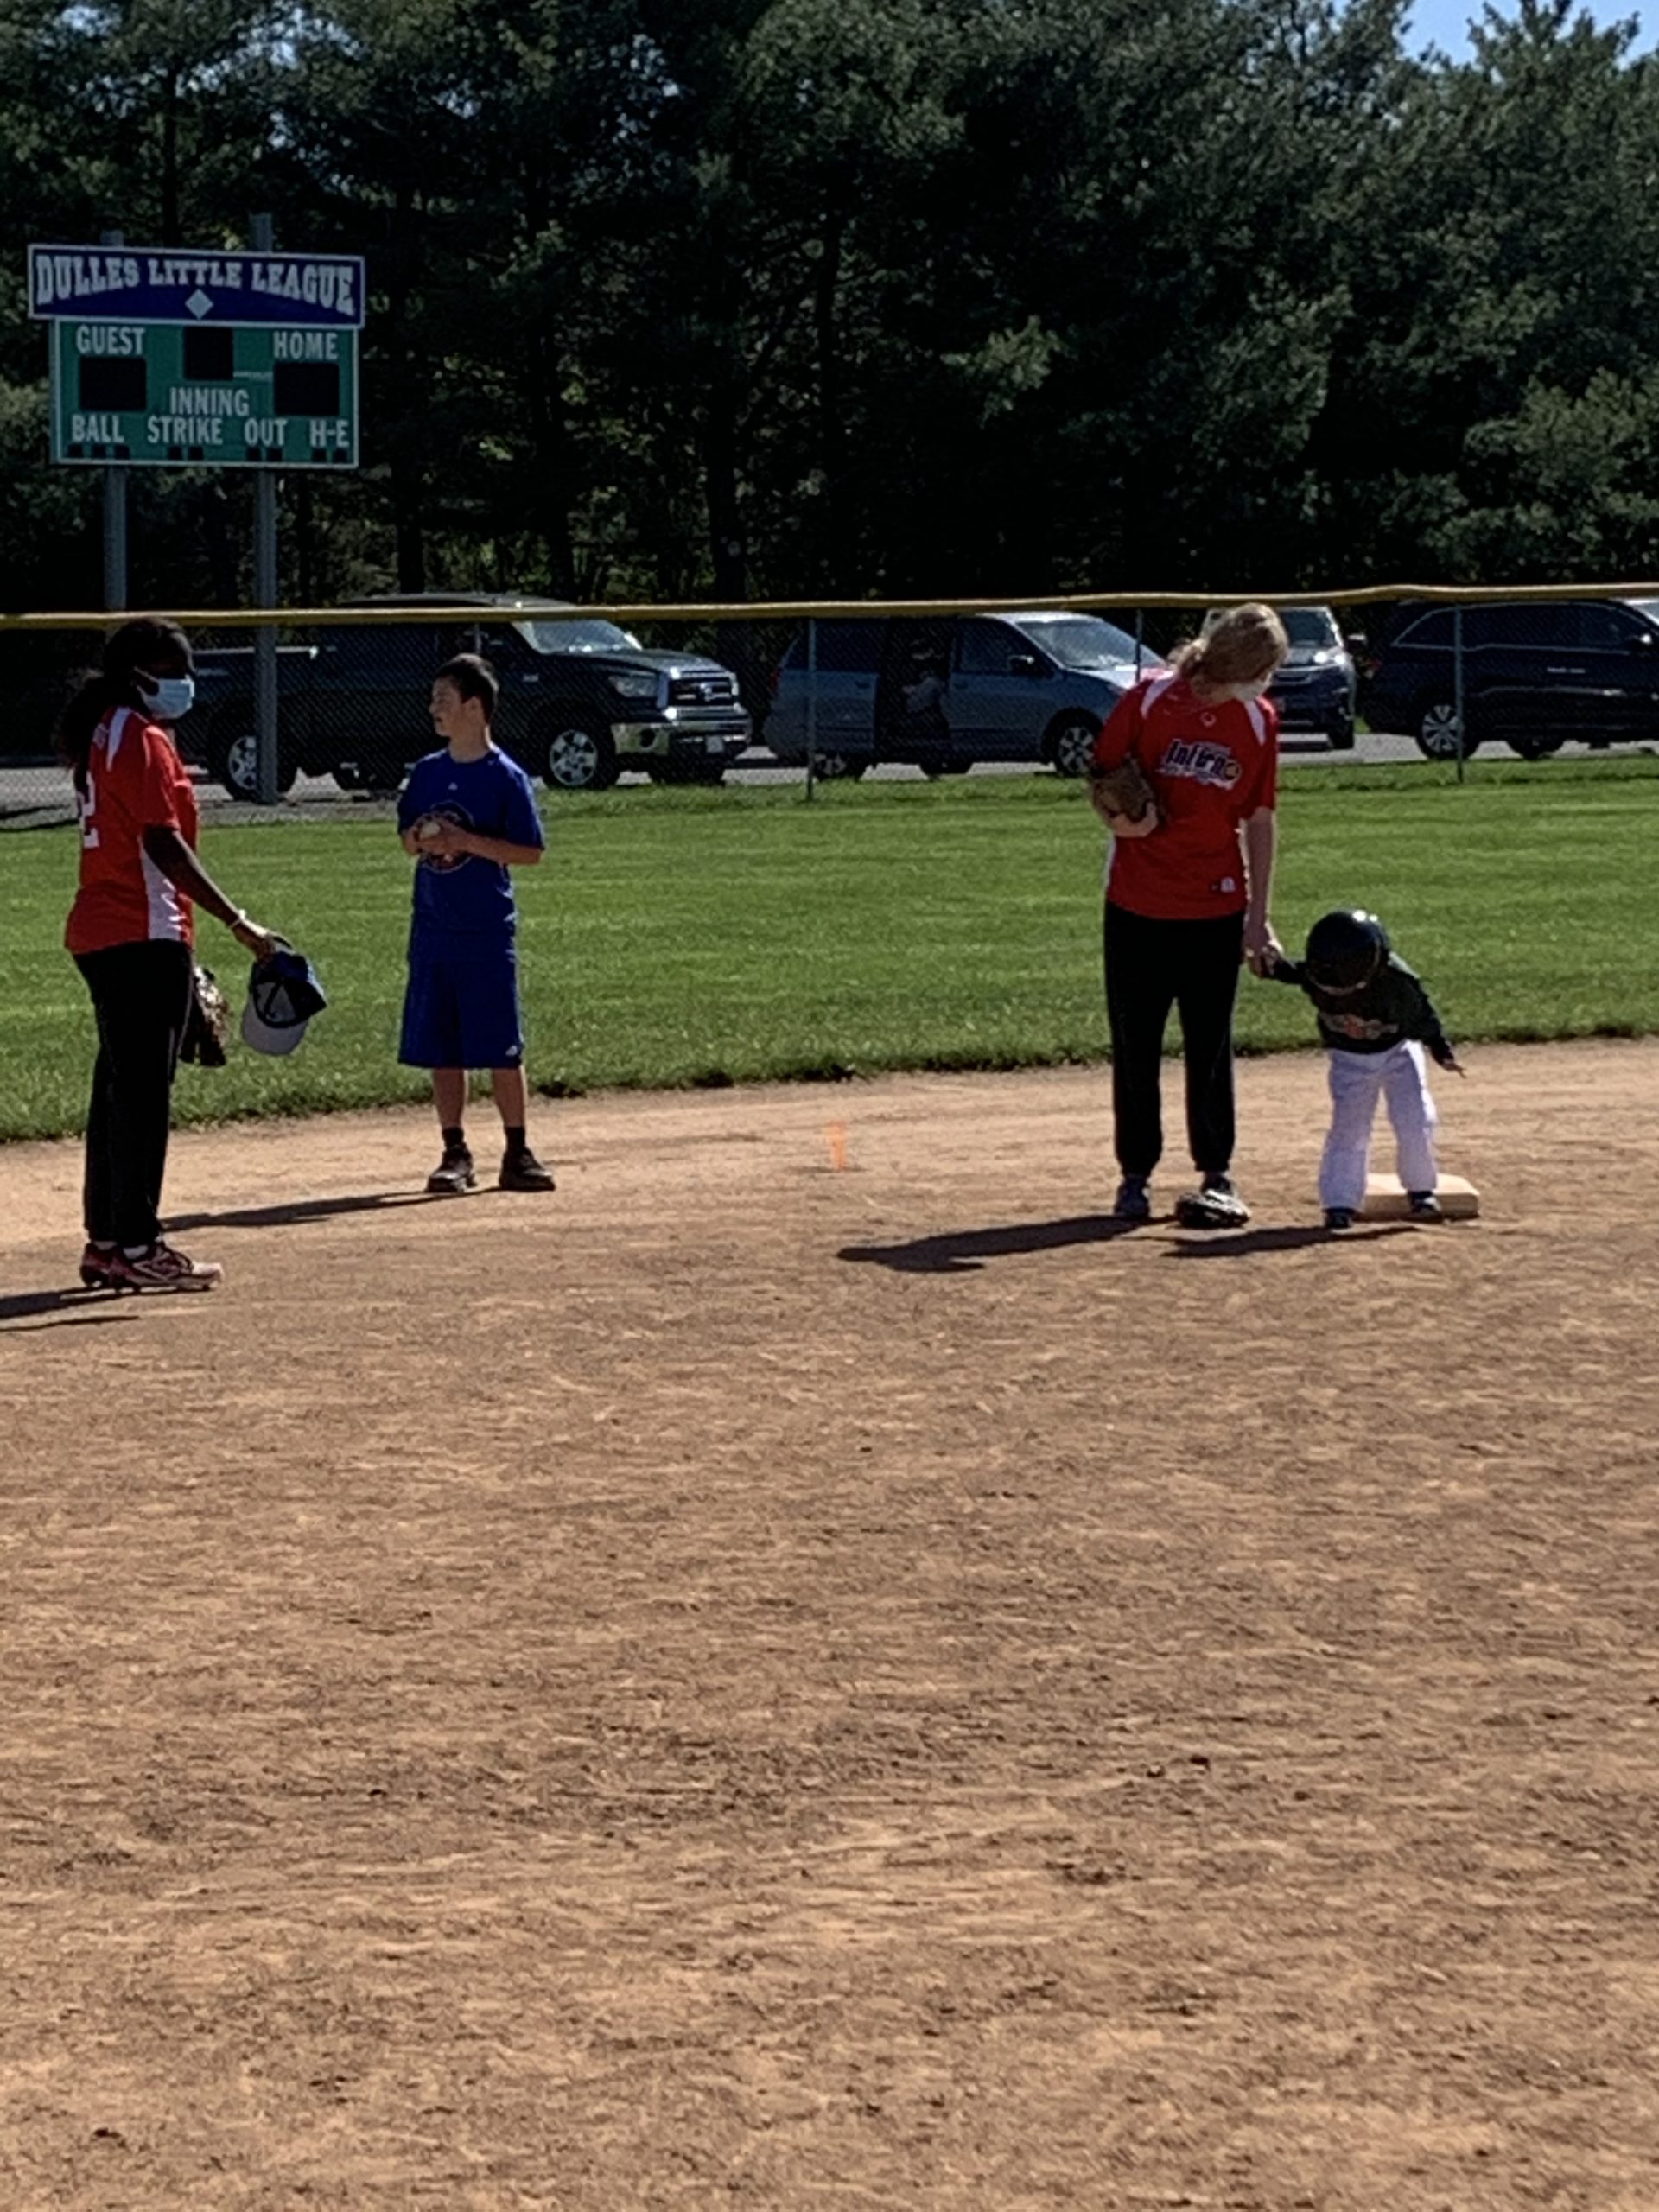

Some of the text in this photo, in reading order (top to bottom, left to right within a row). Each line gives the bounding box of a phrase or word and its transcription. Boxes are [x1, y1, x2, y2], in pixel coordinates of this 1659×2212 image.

[35, 254, 356, 316] DULLES LITTLE LEAGUE
[75, 325, 146, 355] GUEST
[273, 331, 339, 361] HOME
[169, 387, 250, 416] INNING
[71, 415, 350, 448] BALL STRIKE OUT H-E
